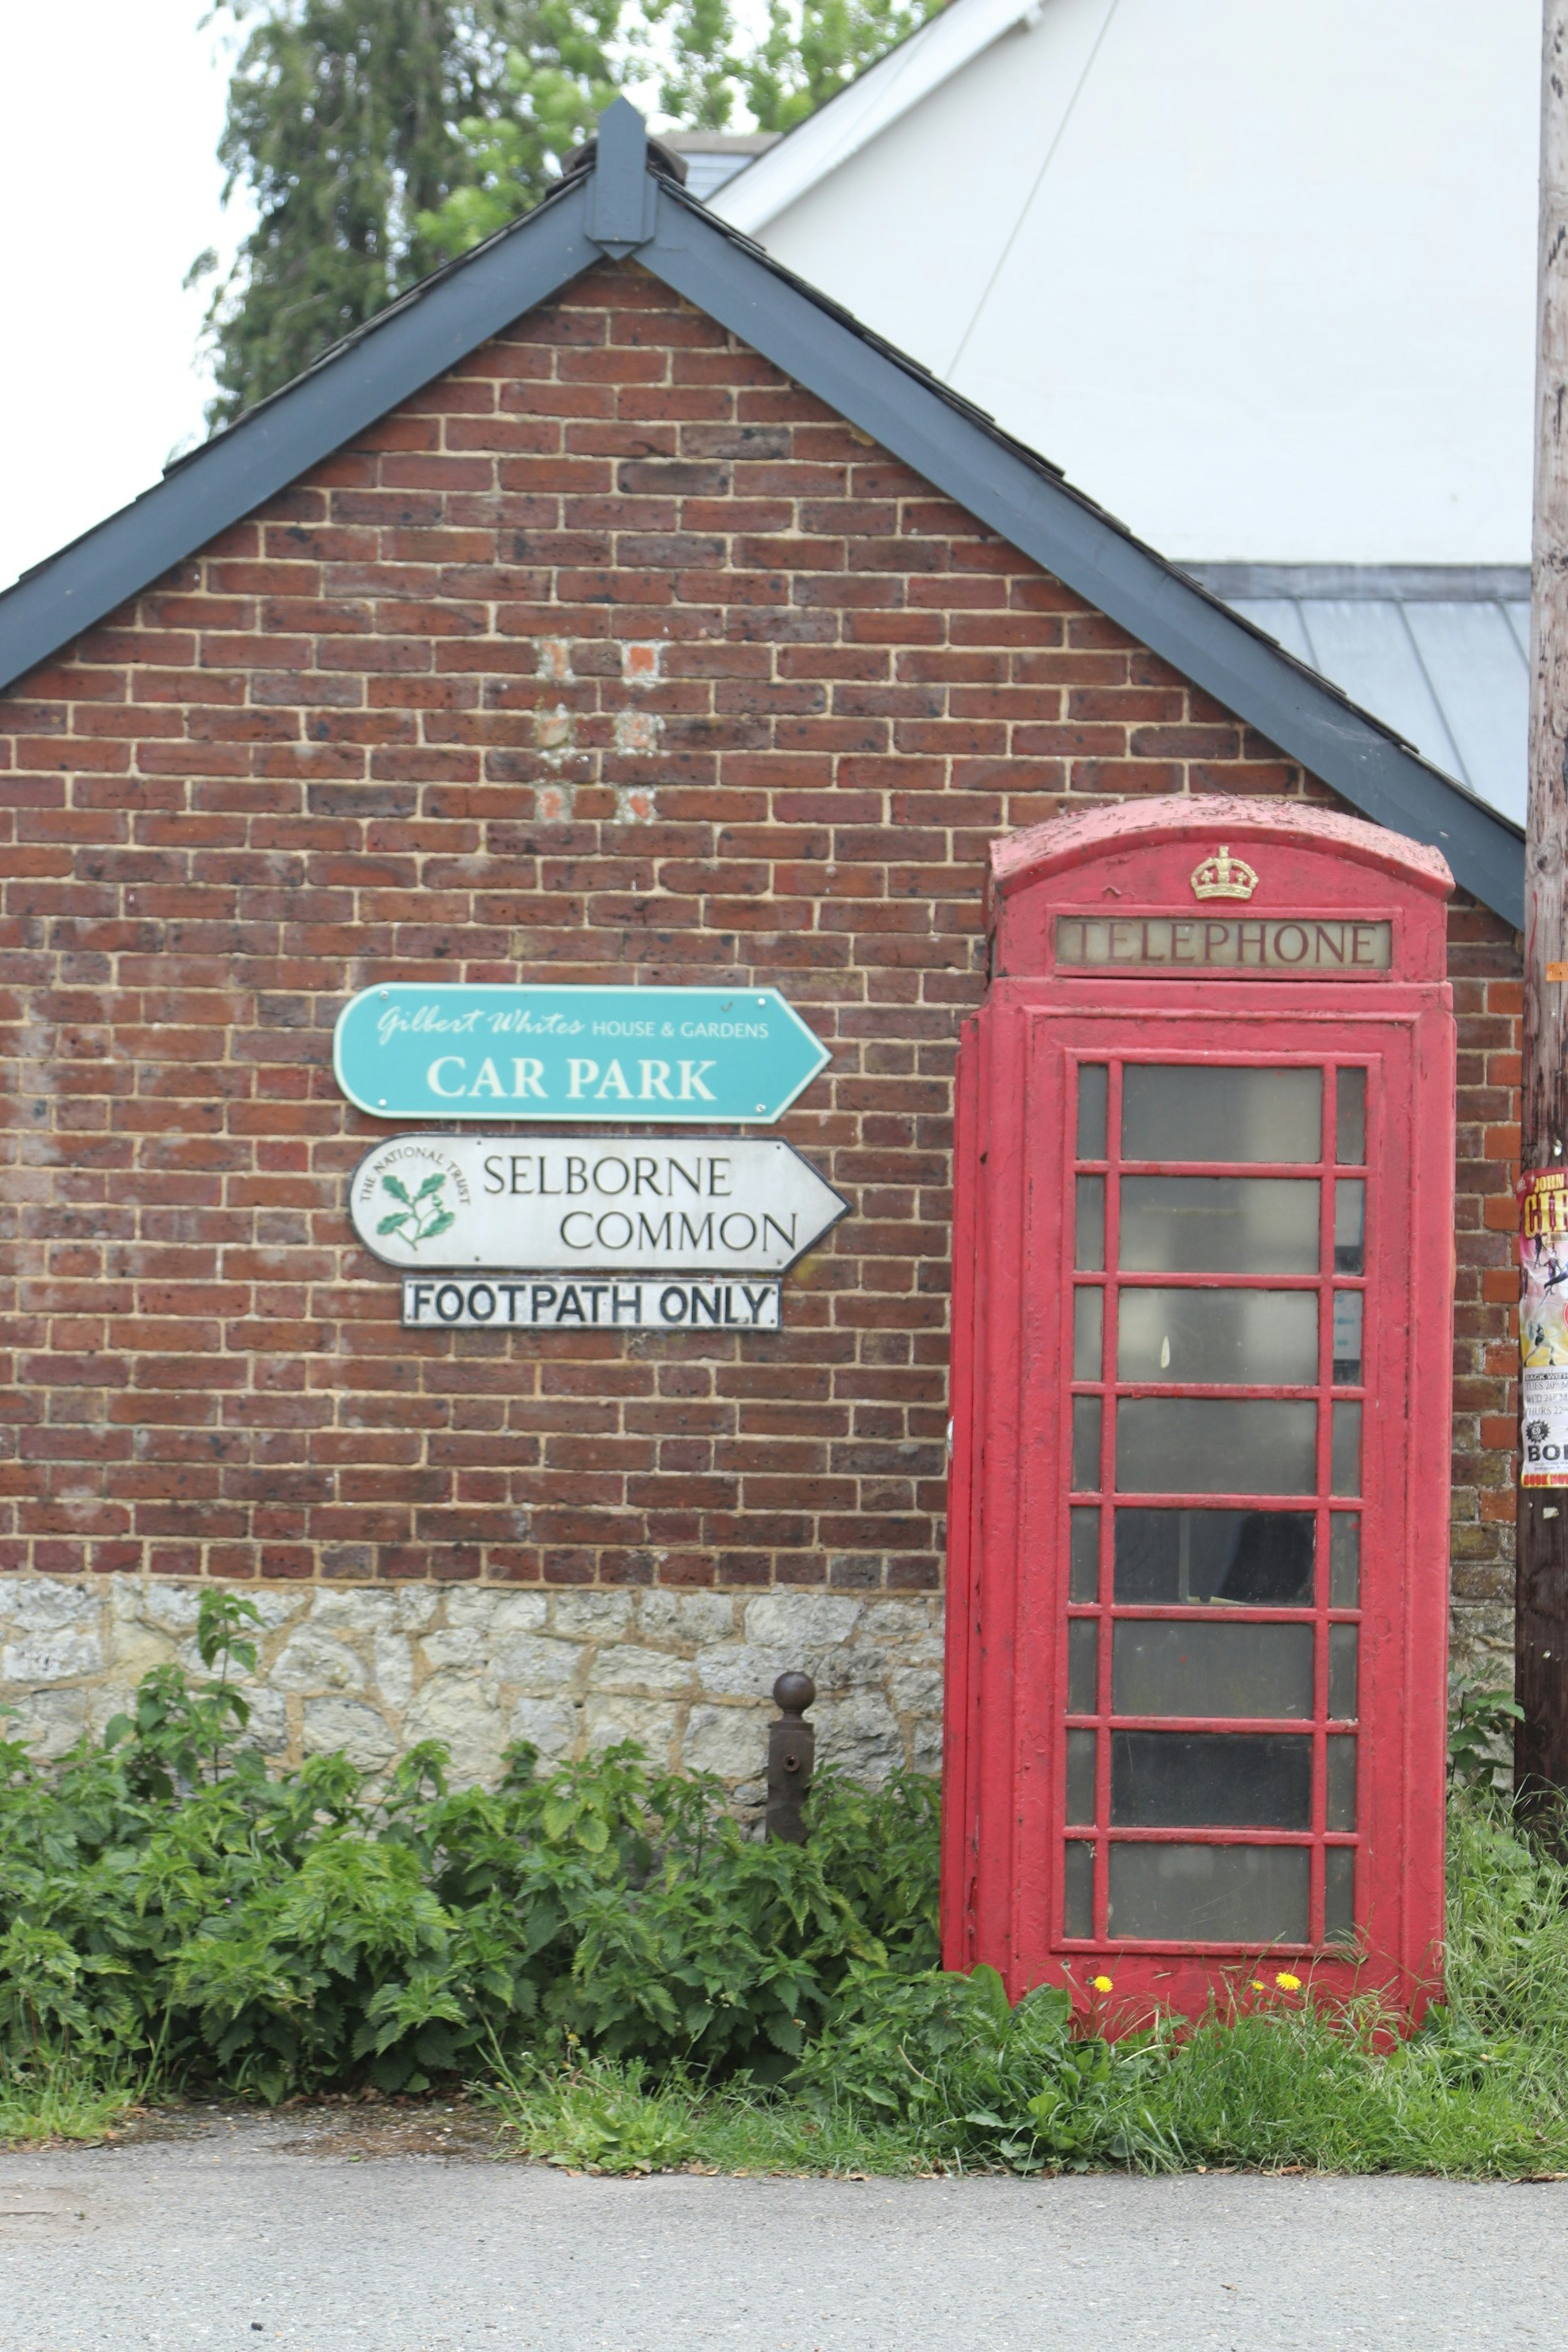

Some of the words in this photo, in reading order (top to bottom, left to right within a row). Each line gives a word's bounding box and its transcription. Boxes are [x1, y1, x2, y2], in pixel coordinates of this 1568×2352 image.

[1069, 920, 1376, 965] TELEPHONE
[377, 1004, 486, 1046] Gilbert
[592, 1020, 656, 1037] HOUSE
[660, 1021, 675, 1037] &
[680, 1021, 770, 1038] GARDENS
[426, 1055, 550, 1099] CAR
[565, 1057, 718, 1100] PARK
[359, 1174, 376, 1203] THE
[373, 1146, 445, 1173] NATIONAL
[447, 1160, 472, 1207] TRUST
[483, 1155, 733, 1197] SELBORNE
[1535, 1174, 1565, 1193] JOHN
[560, 1210, 798, 1253] COMMON
[411, 1282, 643, 1324] FOOTPATH
[660, 1284, 775, 1325] ONLY
[1528, 1443, 1568, 1462] BO
